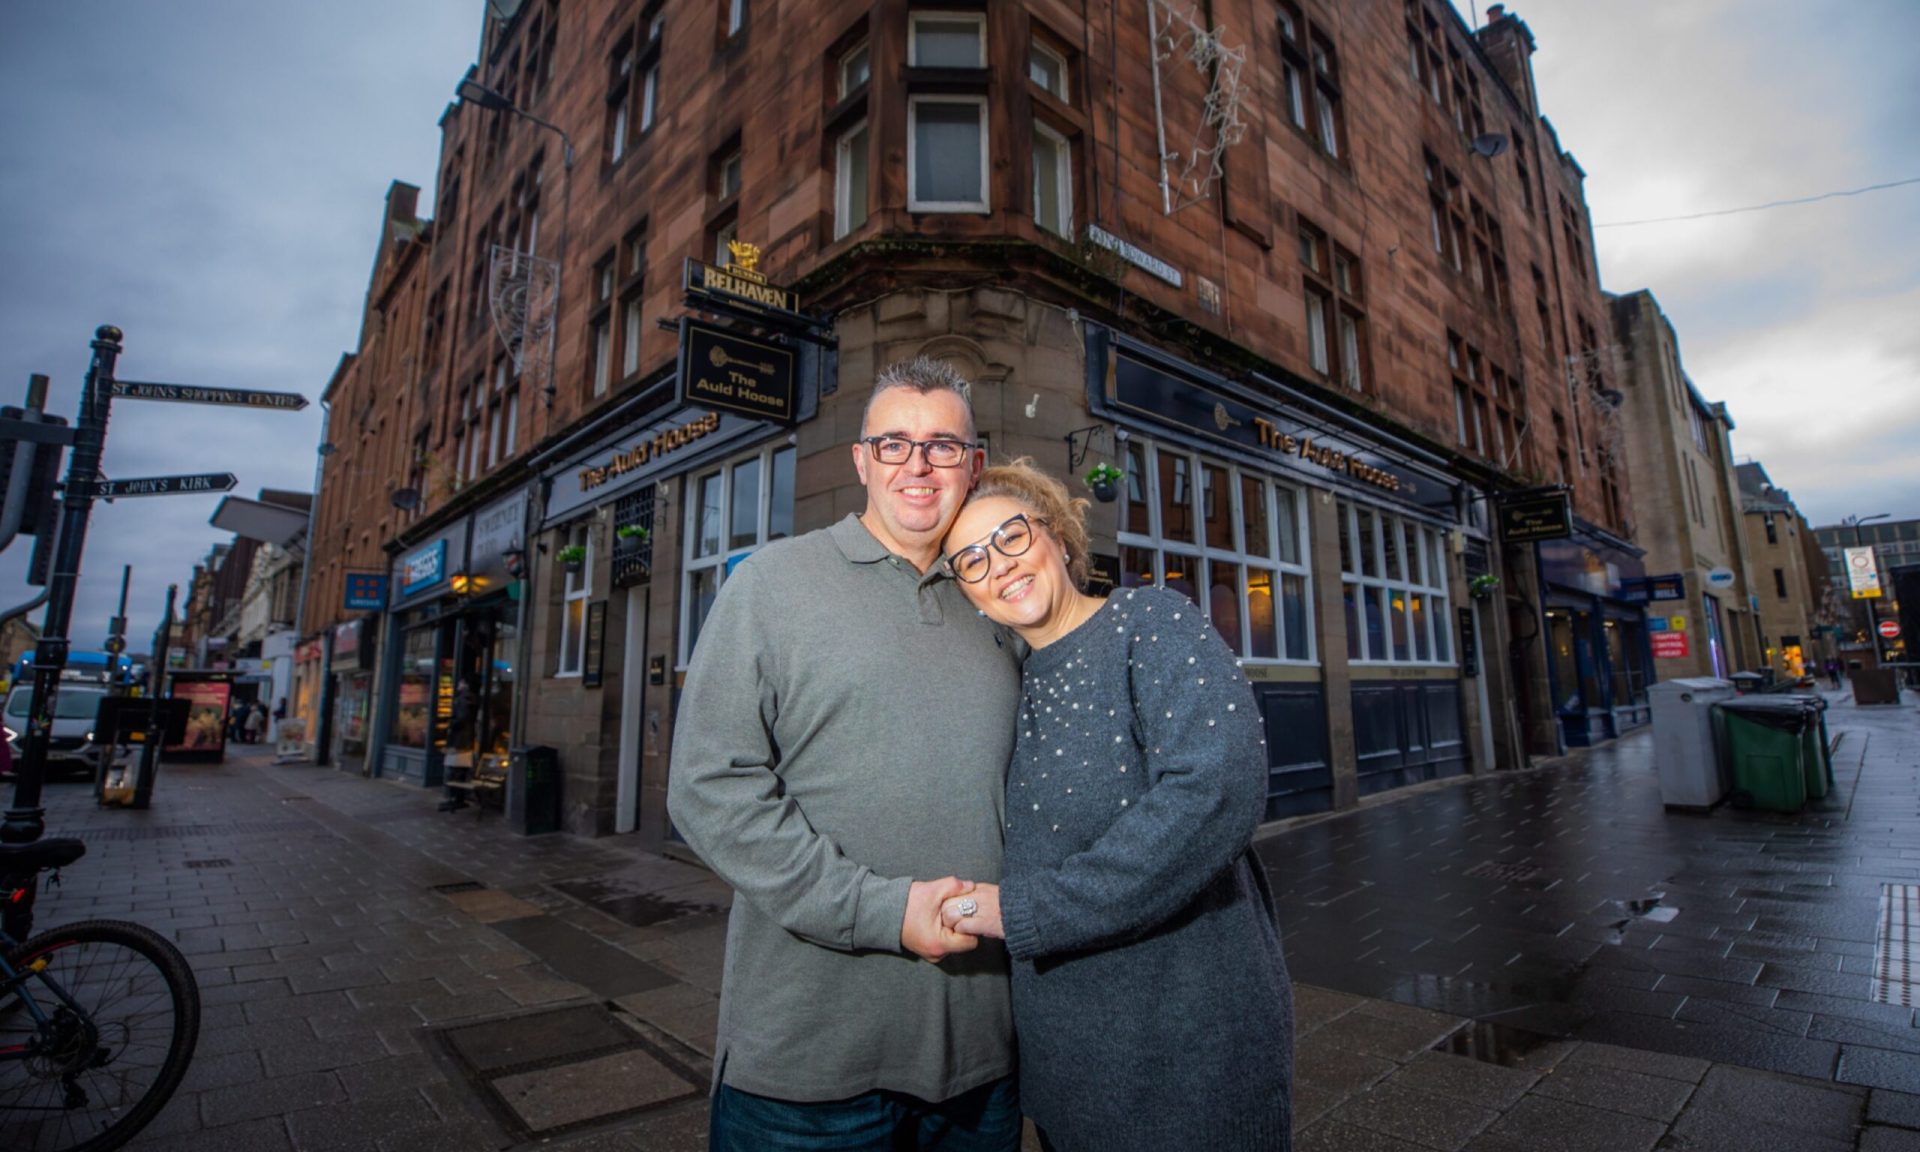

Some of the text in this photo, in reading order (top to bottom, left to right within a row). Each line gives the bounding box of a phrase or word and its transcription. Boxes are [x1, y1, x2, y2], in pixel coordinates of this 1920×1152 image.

[704, 265, 787, 310] BELHAVEN
[696, 378, 785, 408] Auld Hoose
[729, 370, 757, 387] The
[112, 383, 129, 395] ST
[247, 394, 298, 407] CENTRE
[1253, 416, 1297, 454] The
[1300, 436, 1346, 471] Auld
[578, 467, 606, 492] The
[608, 440, 650, 478] Auld
[99, 477, 213, 495] ST JOHN'S KIRK
